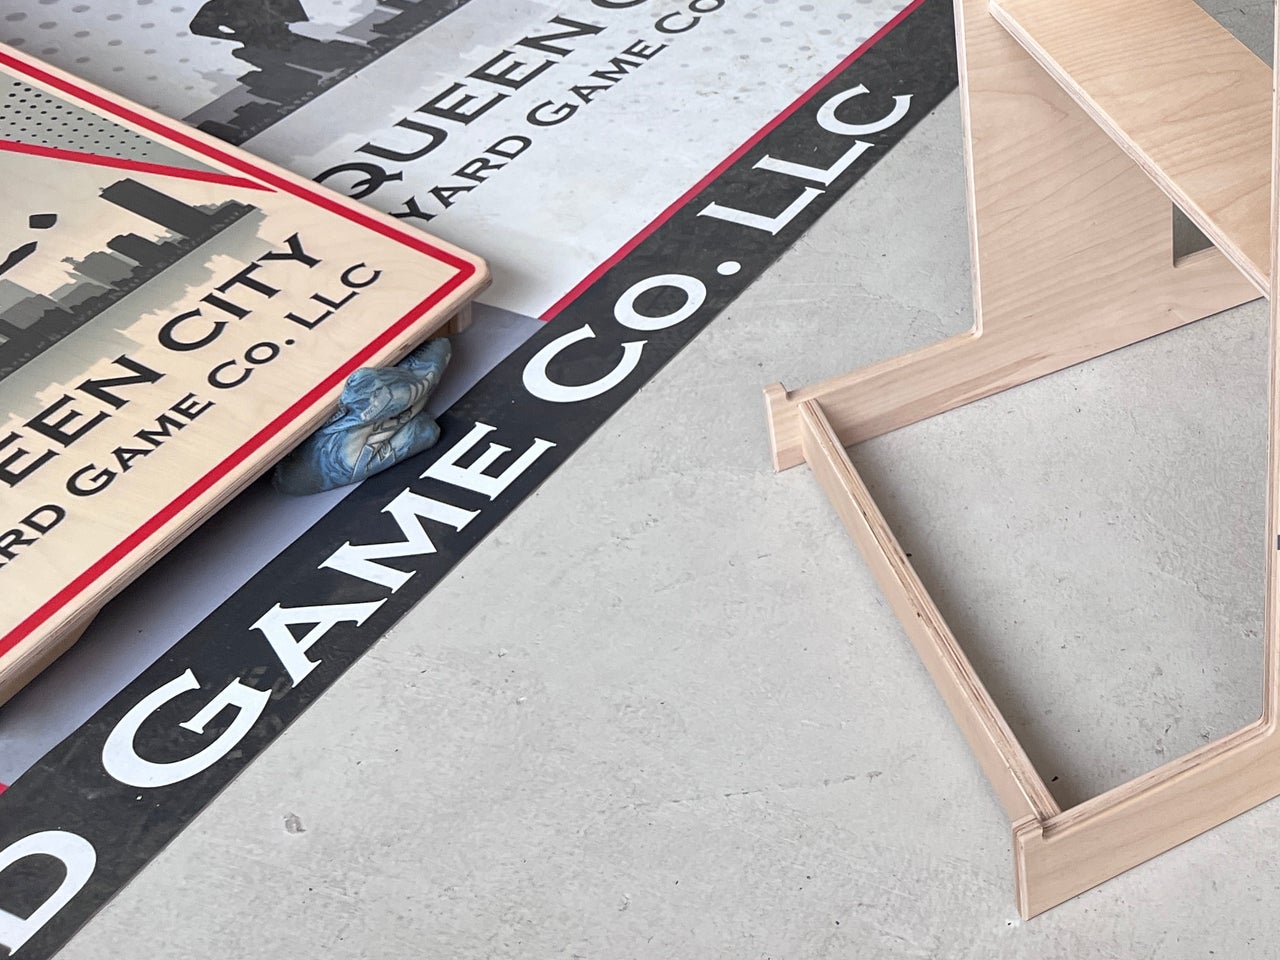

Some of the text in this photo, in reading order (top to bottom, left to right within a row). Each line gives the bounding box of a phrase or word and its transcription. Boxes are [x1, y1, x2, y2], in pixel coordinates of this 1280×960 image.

[313, 15, 608, 200] QUEEN
[388, 134, 532, 223] YARD
[526, 39, 668, 127] GAME
[157, 232, 323, 352] CITY
[0, 504, 67, 569] RD
[66, 393, 216, 498] GAME
[287, 261, 383, 330] LLC
[101, 421, 557, 789] GAME
[696, 83, 914, 237] LLC
